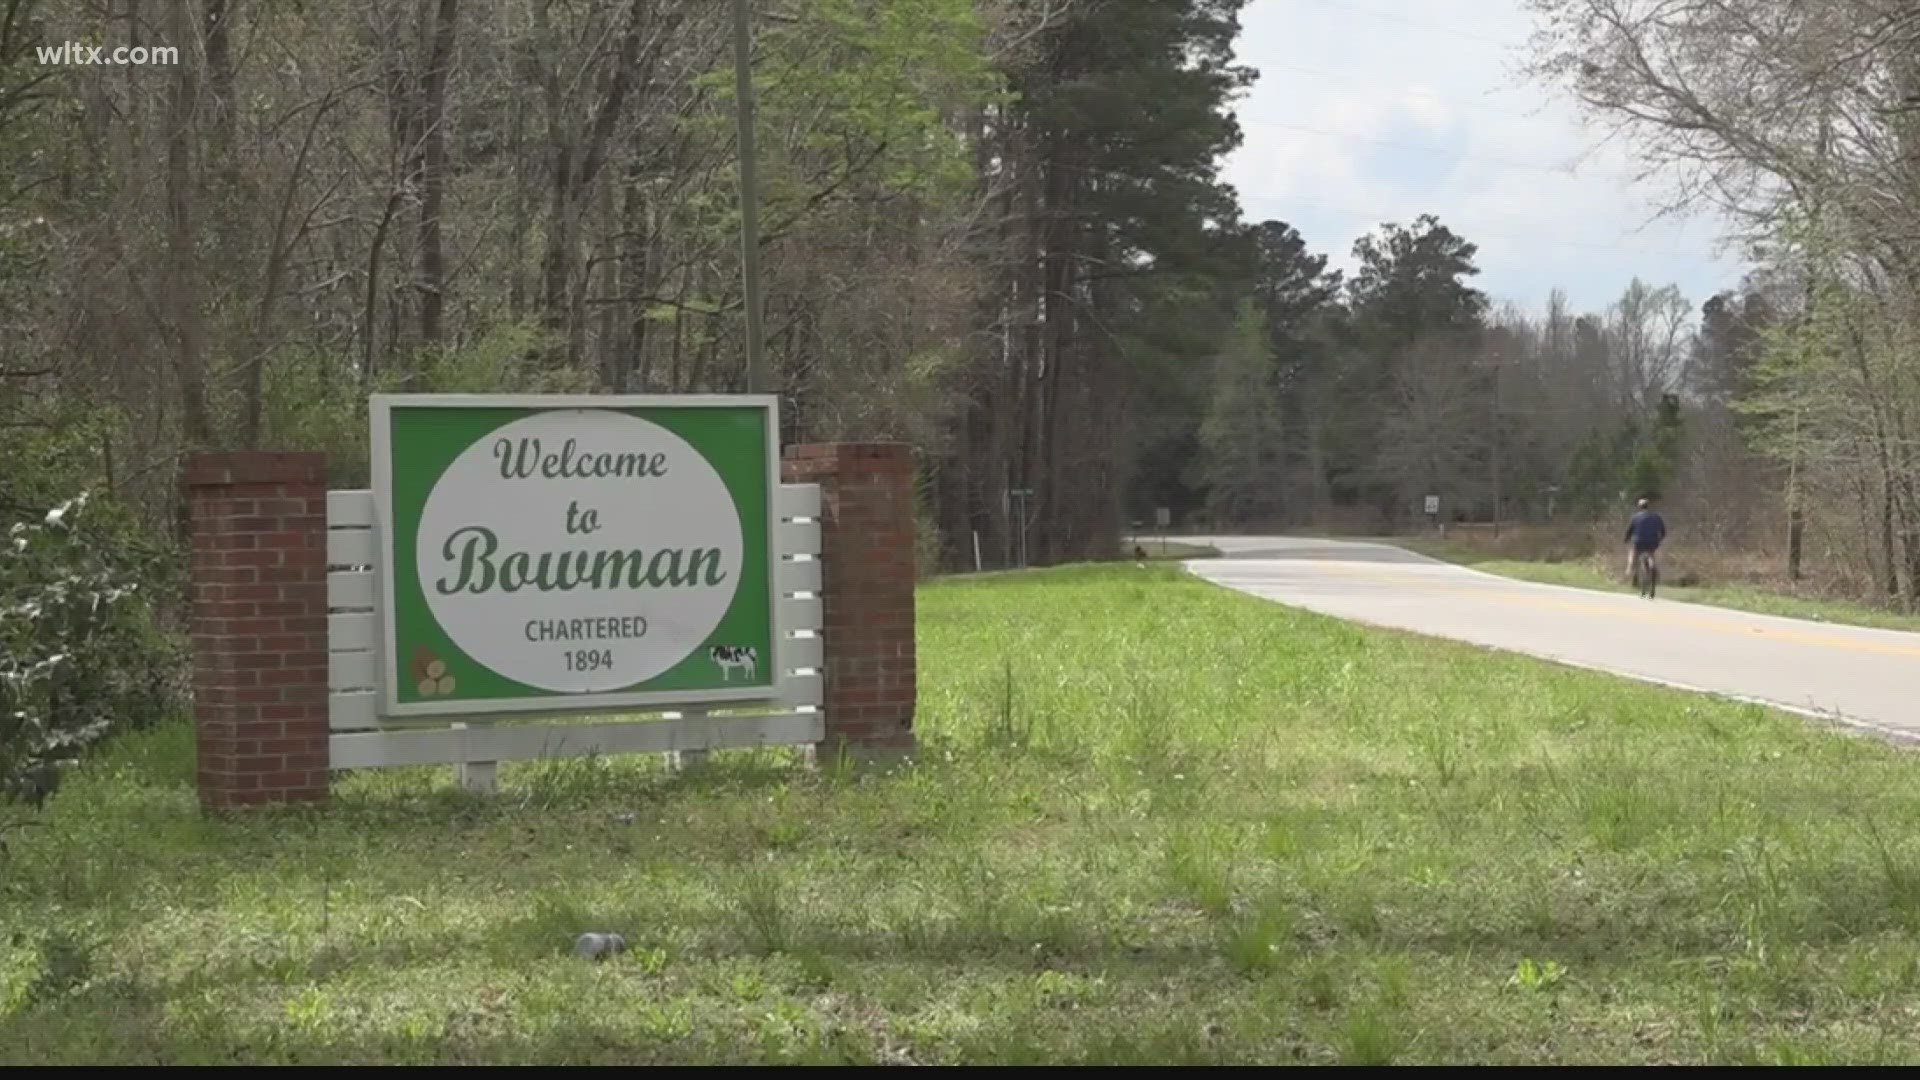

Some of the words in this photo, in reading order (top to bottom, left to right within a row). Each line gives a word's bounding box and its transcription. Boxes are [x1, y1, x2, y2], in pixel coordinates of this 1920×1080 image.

[494, 438, 667, 479] Welcome
[566, 501, 601, 534] to
[436, 526, 727, 595] Bowman
[525, 616, 647, 642] CHARTERED
[564, 650, 613, 671] 1894
